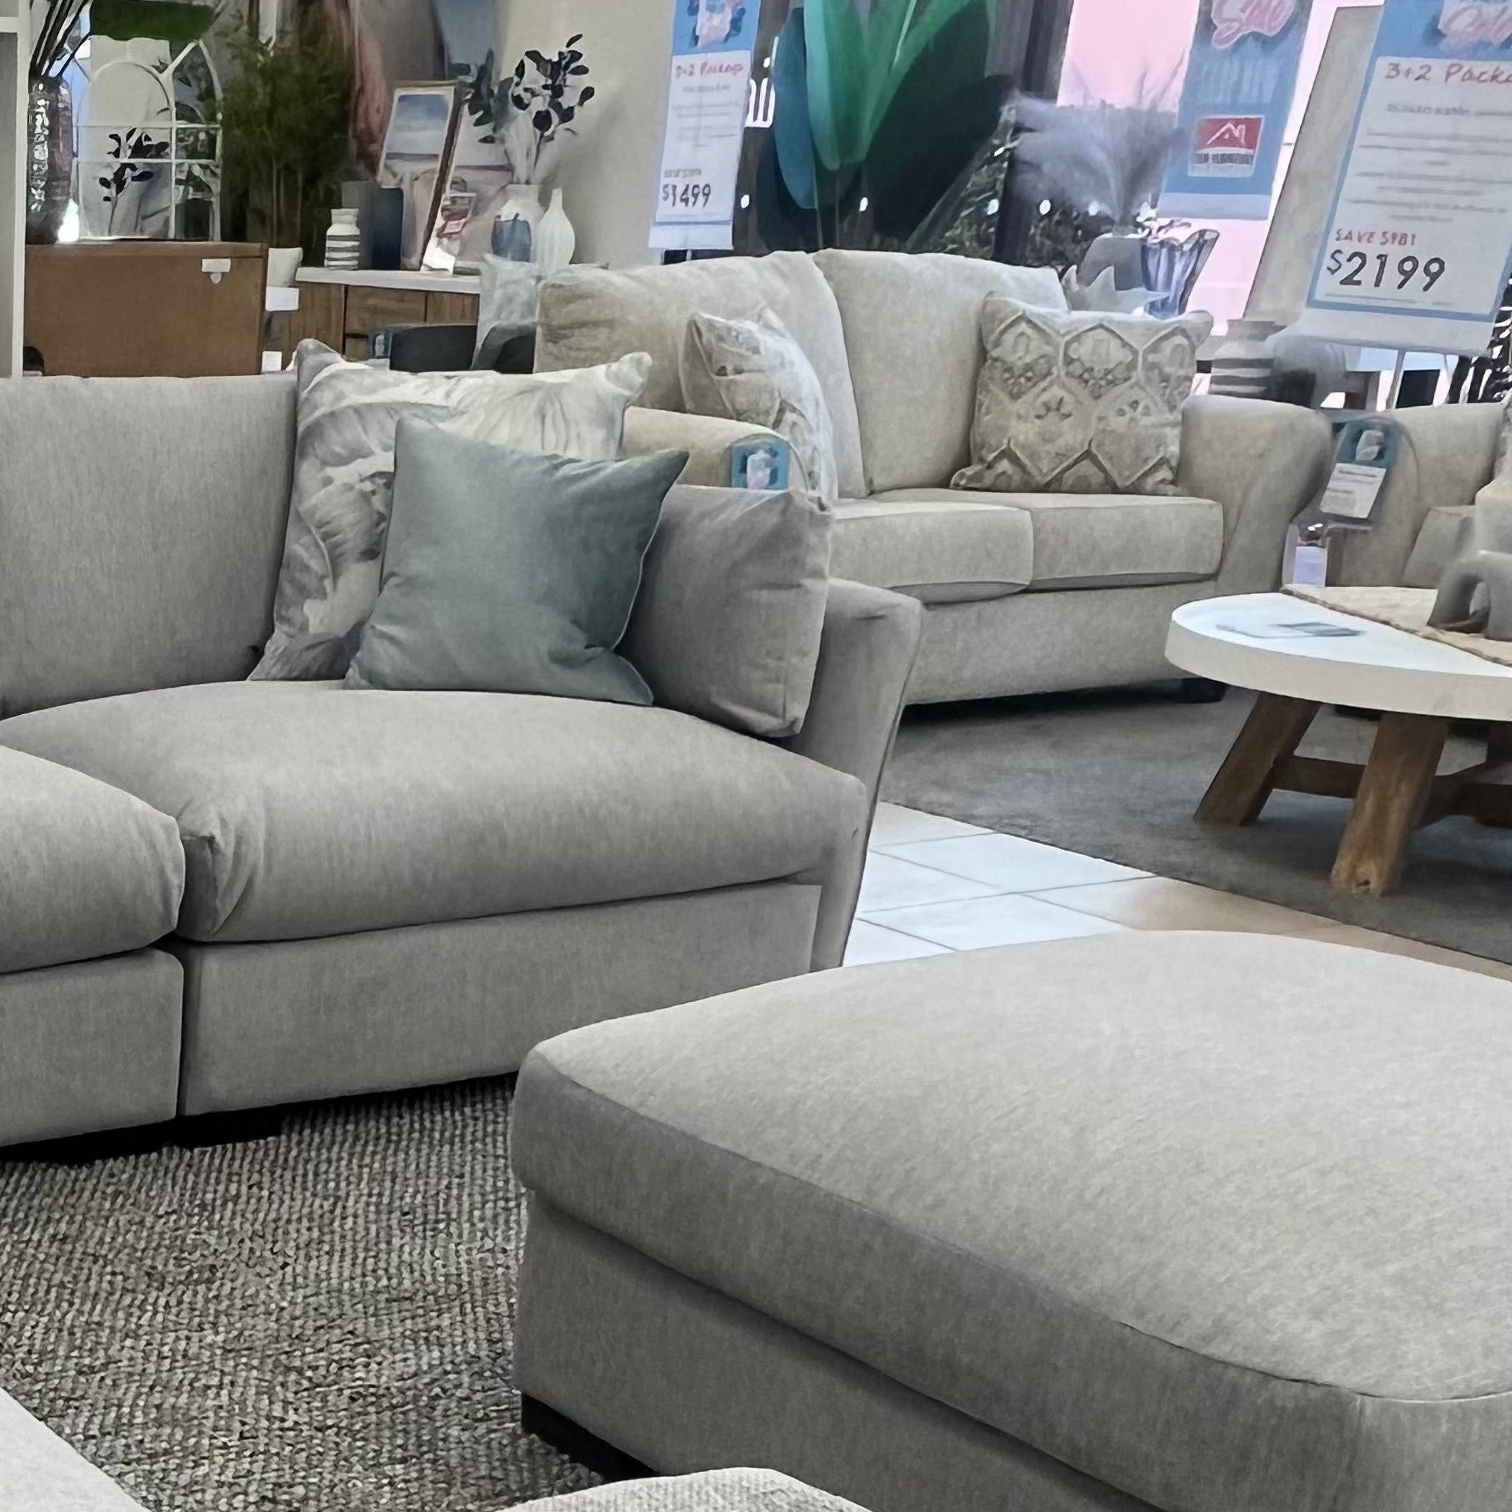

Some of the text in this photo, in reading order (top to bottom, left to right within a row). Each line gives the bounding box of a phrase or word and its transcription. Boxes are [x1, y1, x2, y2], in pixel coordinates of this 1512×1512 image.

[662, 183, 711, 207] $1499
[1334, 228, 1376, 244] SAVE
[1326, 249, 1446, 292] $2199
